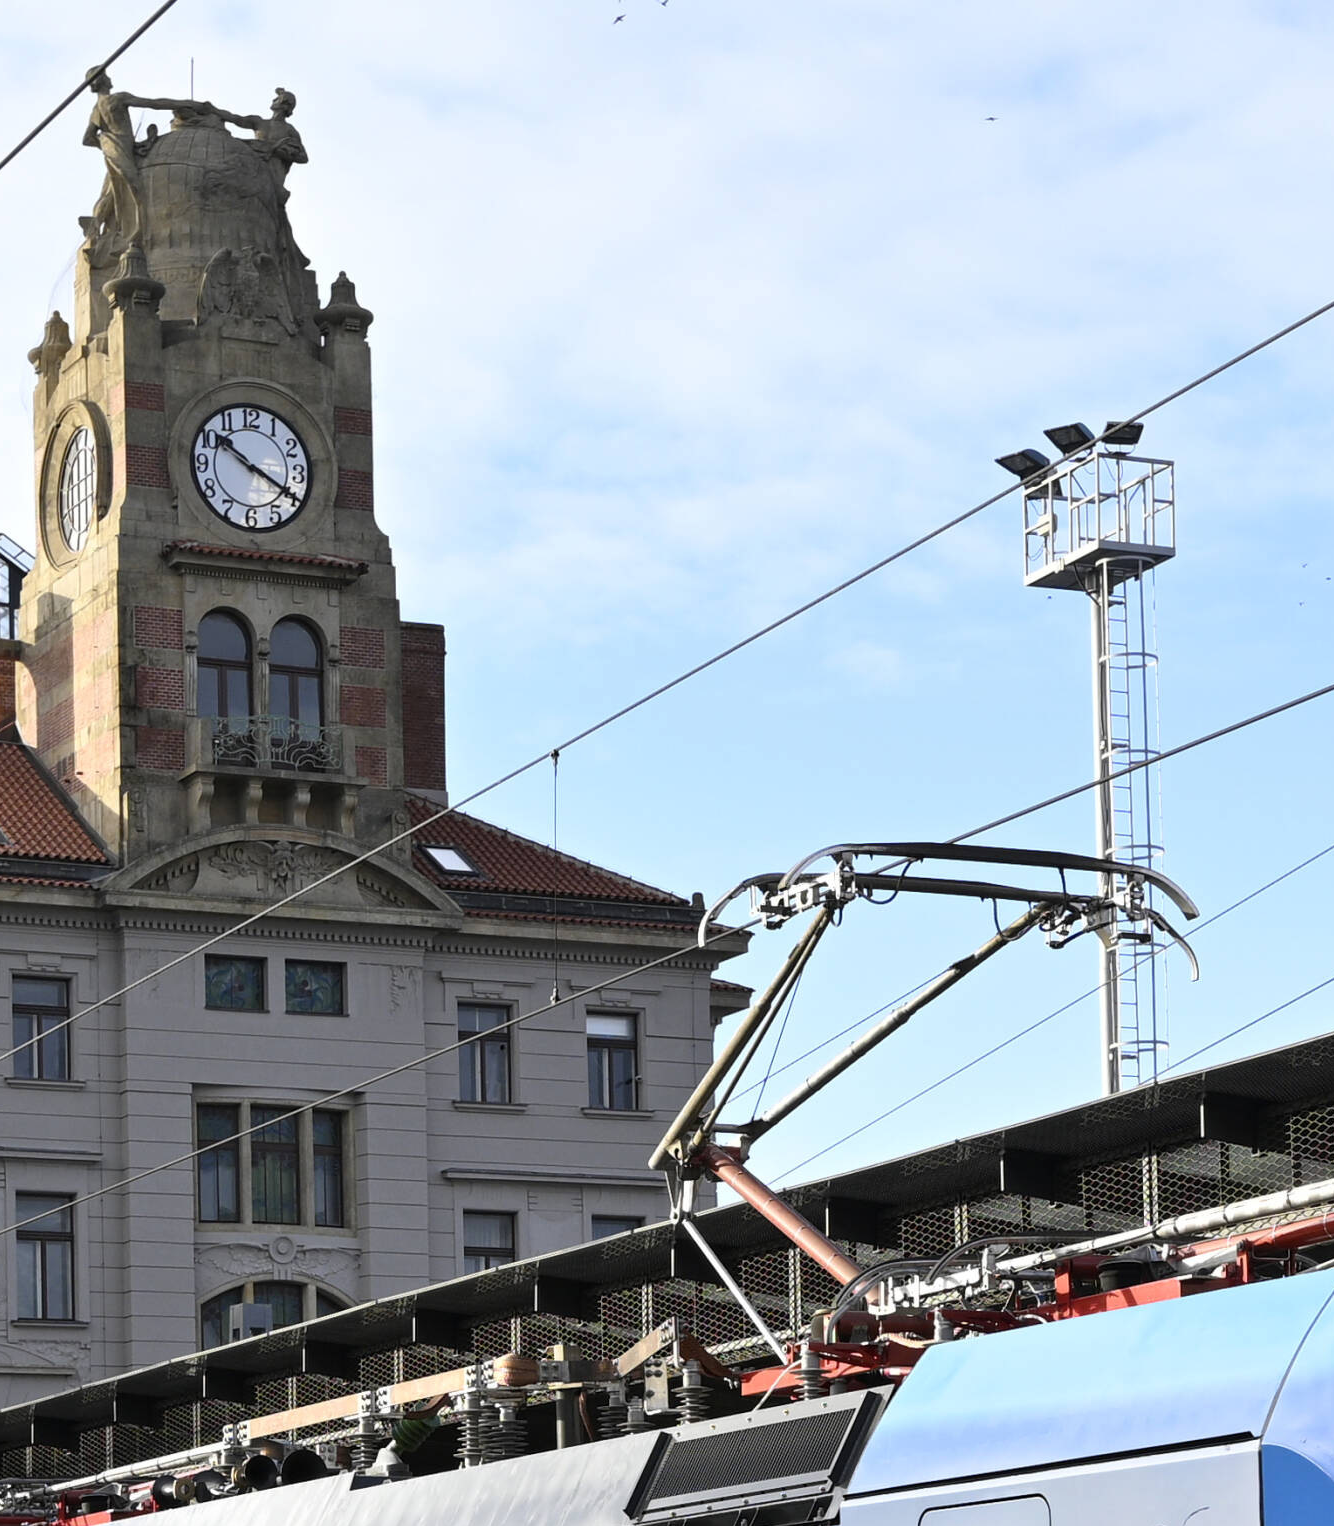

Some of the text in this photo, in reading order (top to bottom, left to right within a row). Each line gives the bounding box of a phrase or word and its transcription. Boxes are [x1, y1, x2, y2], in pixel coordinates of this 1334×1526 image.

[220, 411, 234, 431] 11
[242, 408, 261, 429] 12
[269, 418, 277, 437] 1
[201, 428, 218, 449] 10
[285, 438, 298, 458] 2
[196, 453, 209, 473] 9
[292, 464, 305, 484] 3
[203, 478, 216, 498] 8
[222, 499, 234, 521] 7
[245, 508, 258, 528] 6
[269, 504, 282, 525] 5
